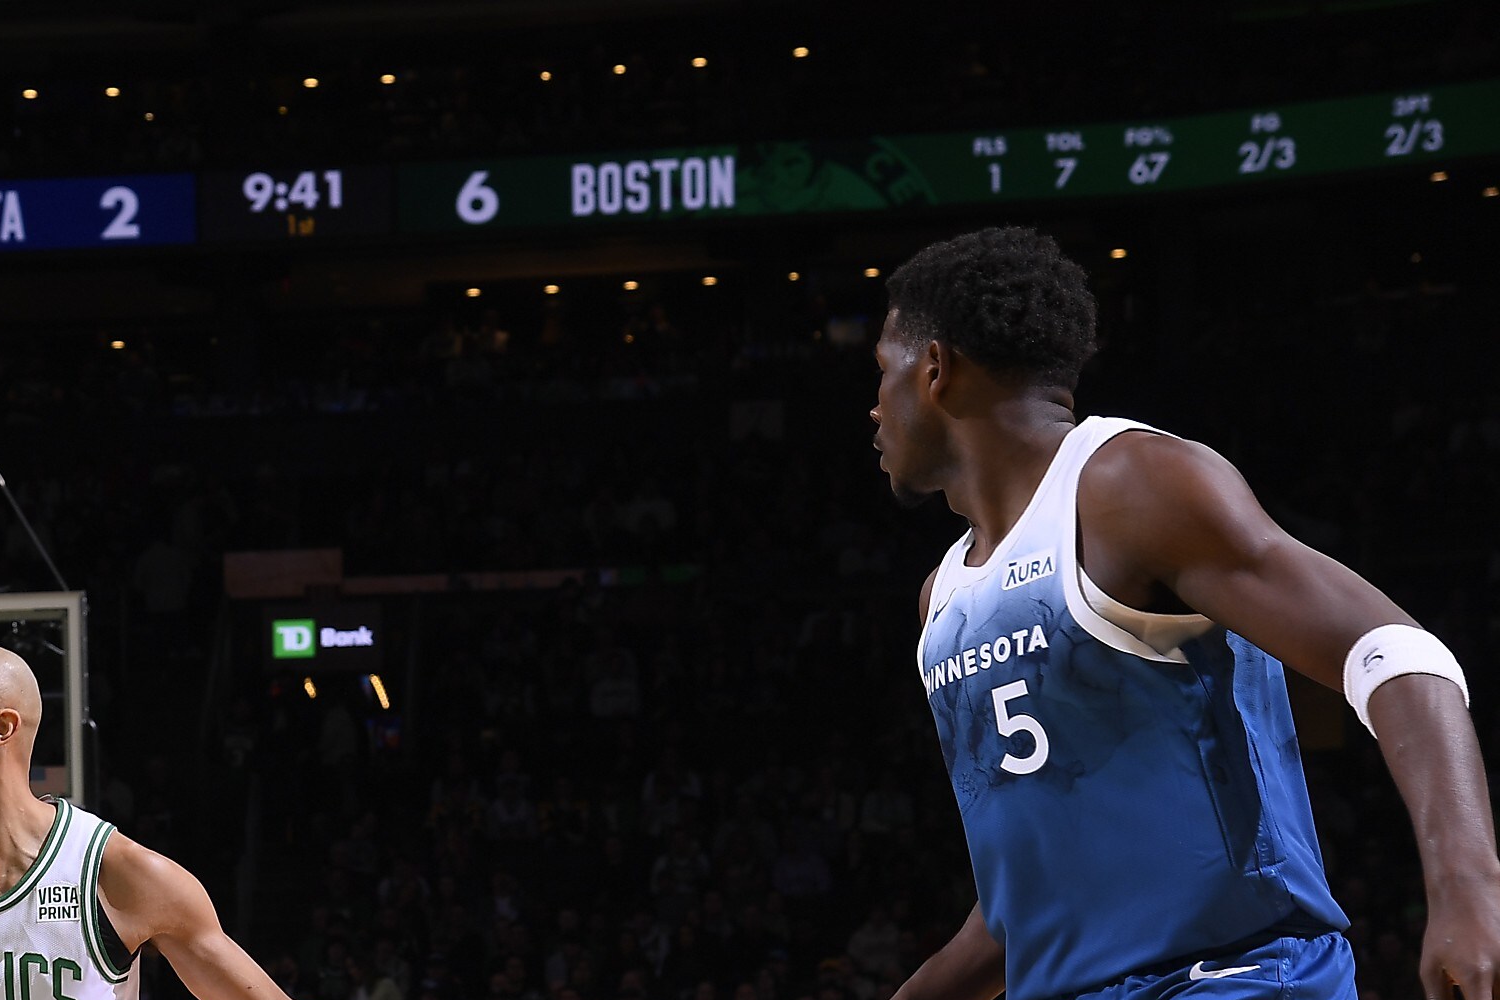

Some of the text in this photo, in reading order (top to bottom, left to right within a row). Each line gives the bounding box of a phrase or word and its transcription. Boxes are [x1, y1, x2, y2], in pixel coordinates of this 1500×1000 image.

[988, 118, 1445, 194] 1 7 67 2/3 2/3
[99, 185, 141, 240] 2
[242, 169, 343, 213] 9:41
[455, 155, 736, 225] 6 BOSTON
[275, 625, 374, 652] TD Bank
[991, 678, 1050, 775] 5
[38, 885, 79, 905] VISTA
[38, 905, 80, 920] PRINT
